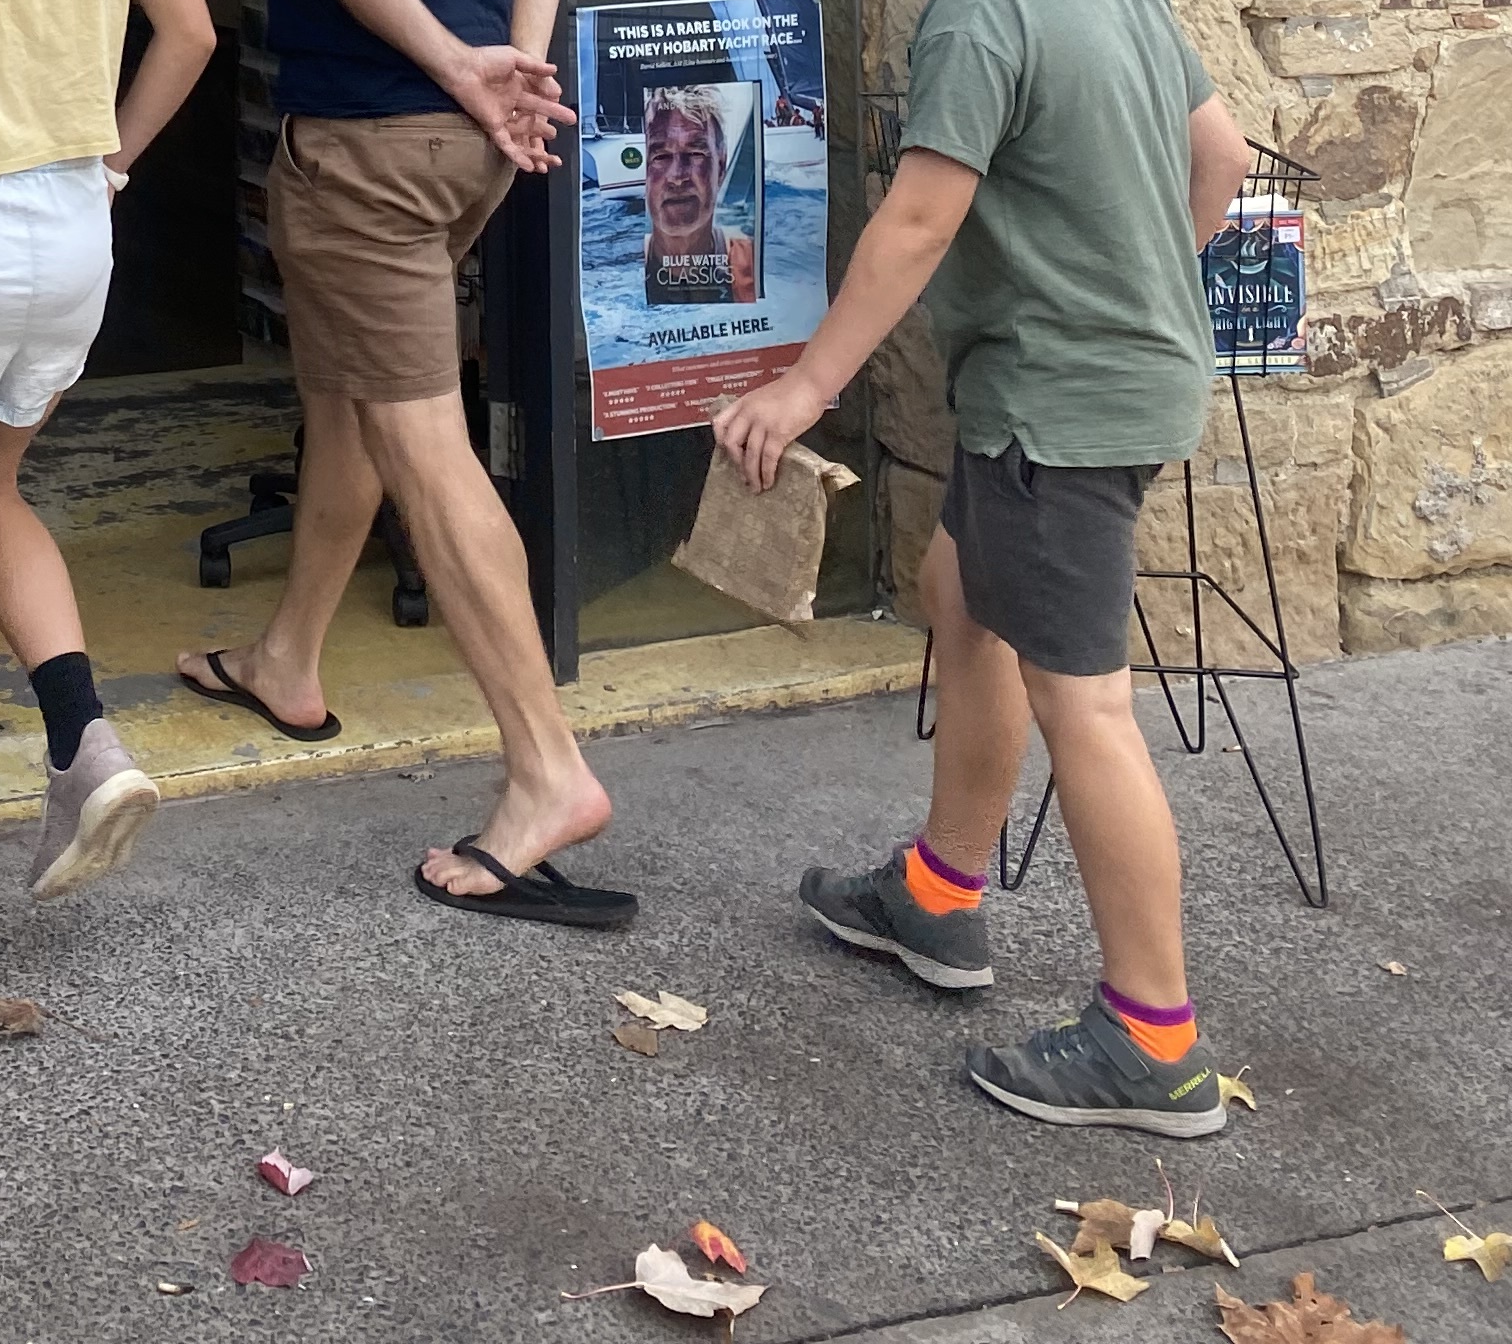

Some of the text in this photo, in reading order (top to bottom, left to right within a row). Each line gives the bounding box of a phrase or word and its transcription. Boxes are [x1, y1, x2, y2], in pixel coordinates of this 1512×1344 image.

[650, 23, 665, 38] IS
[665, 23, 676, 37] A
[676, 20, 712, 36] RARE
[713, 17, 751, 32] BOOK
[752, 15, 772, 30] ON
[772, 13, 799, 28] THE
[608, 42, 661, 59] SYDNEY
[663, 38, 716, 56] HOBART
[716, 34, 760, 51] YACHT
[662, 253, 729, 268] BLUE WATER
[656, 265, 736, 286] CLASSICS
[1207, 283, 1294, 306] INVISIBLE
[647, 317, 774, 348] AVAILABLE HERE.
[1168, 1066, 1214, 1103] MERRELL
